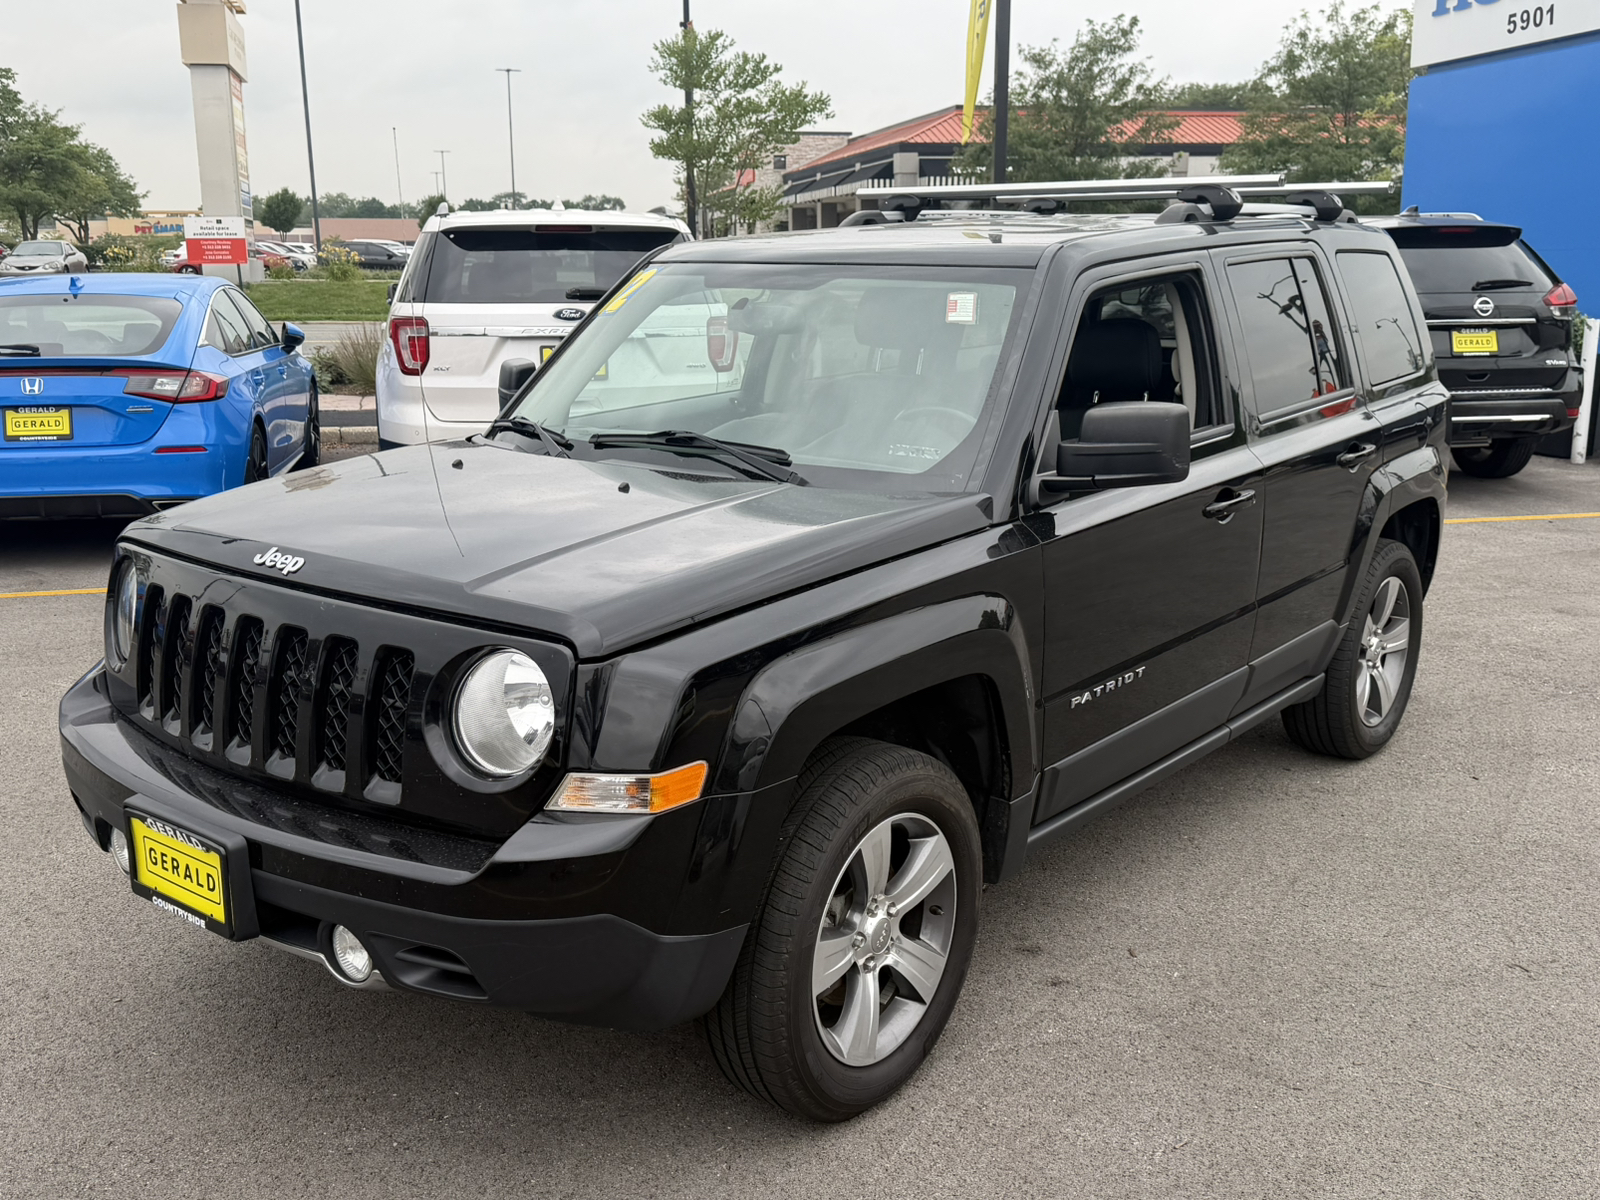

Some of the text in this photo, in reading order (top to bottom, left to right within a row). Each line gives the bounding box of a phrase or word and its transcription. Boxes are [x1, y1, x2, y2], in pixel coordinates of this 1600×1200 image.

[1506, 3, 1554, 34] 5901
[560, 309, 581, 318] Ford
[14, 419, 61, 428] GERALD
[253, 546, 305, 576] Jeep
[1070, 666, 1146, 709] PATRIOT
[146, 818, 203, 850] GERALD
[149, 847, 216, 893] GERALD
[152, 896, 206, 929] COUNTRYSIDE
